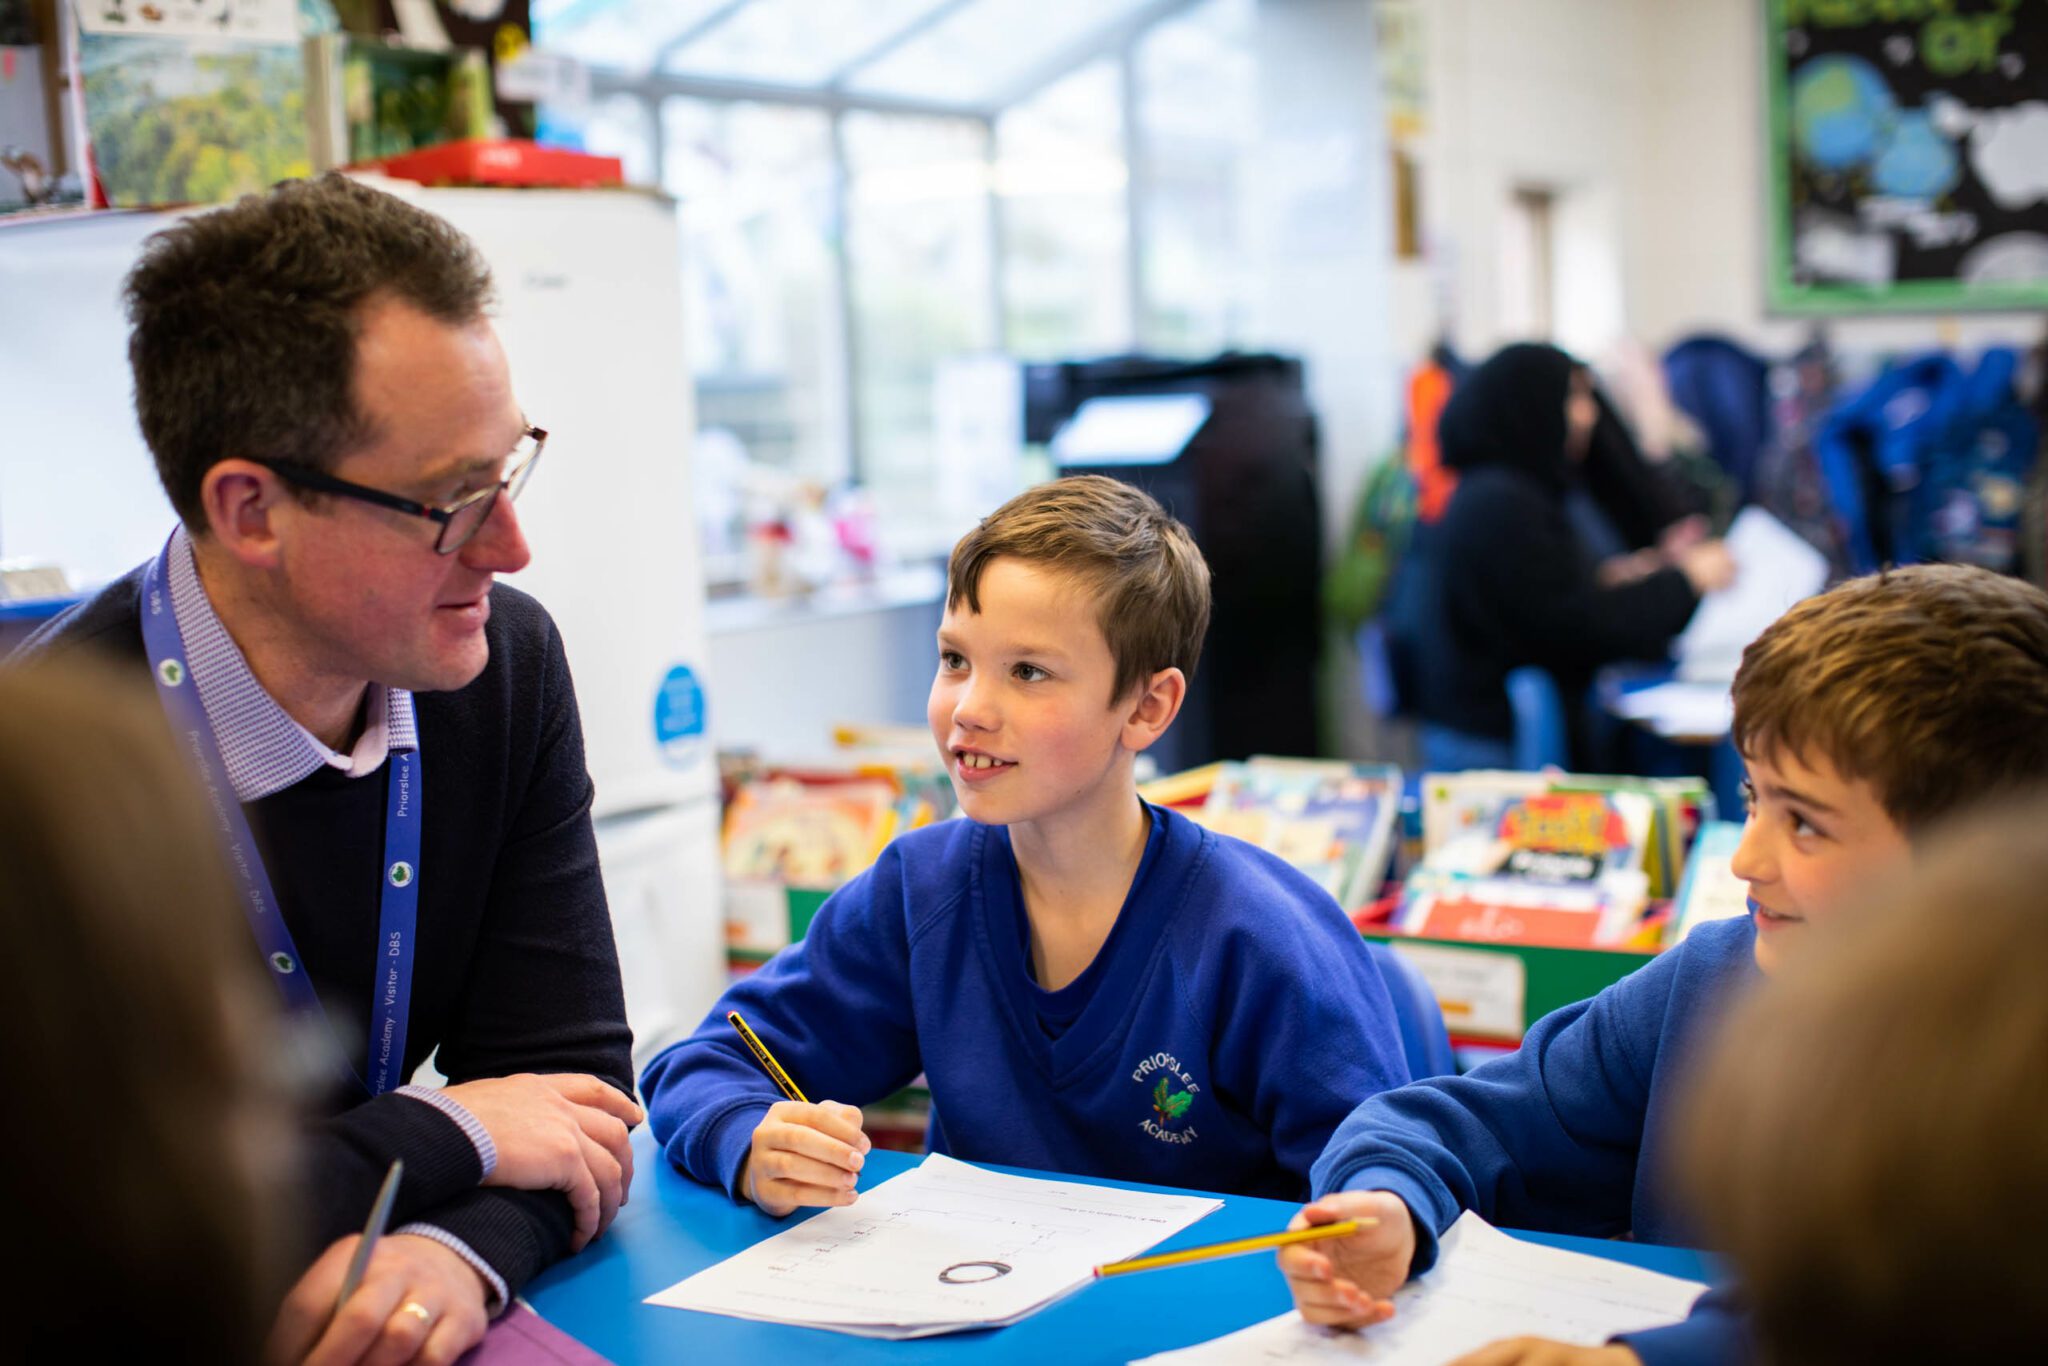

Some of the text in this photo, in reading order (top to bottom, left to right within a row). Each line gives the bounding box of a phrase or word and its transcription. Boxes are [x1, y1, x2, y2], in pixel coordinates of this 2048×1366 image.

[150, 590, 162, 615] DBS
[397, 765, 409, 817] Priorslee
[250, 890, 267, 914] DBS
[388, 931, 401, 956] DBS
[384, 967, 398, 1006] Visitor
[379, 1017, 397, 1066] Academy
[376, 1069, 388, 1096] rslee
[1138, 1119, 1198, 1145] ACADEMY
